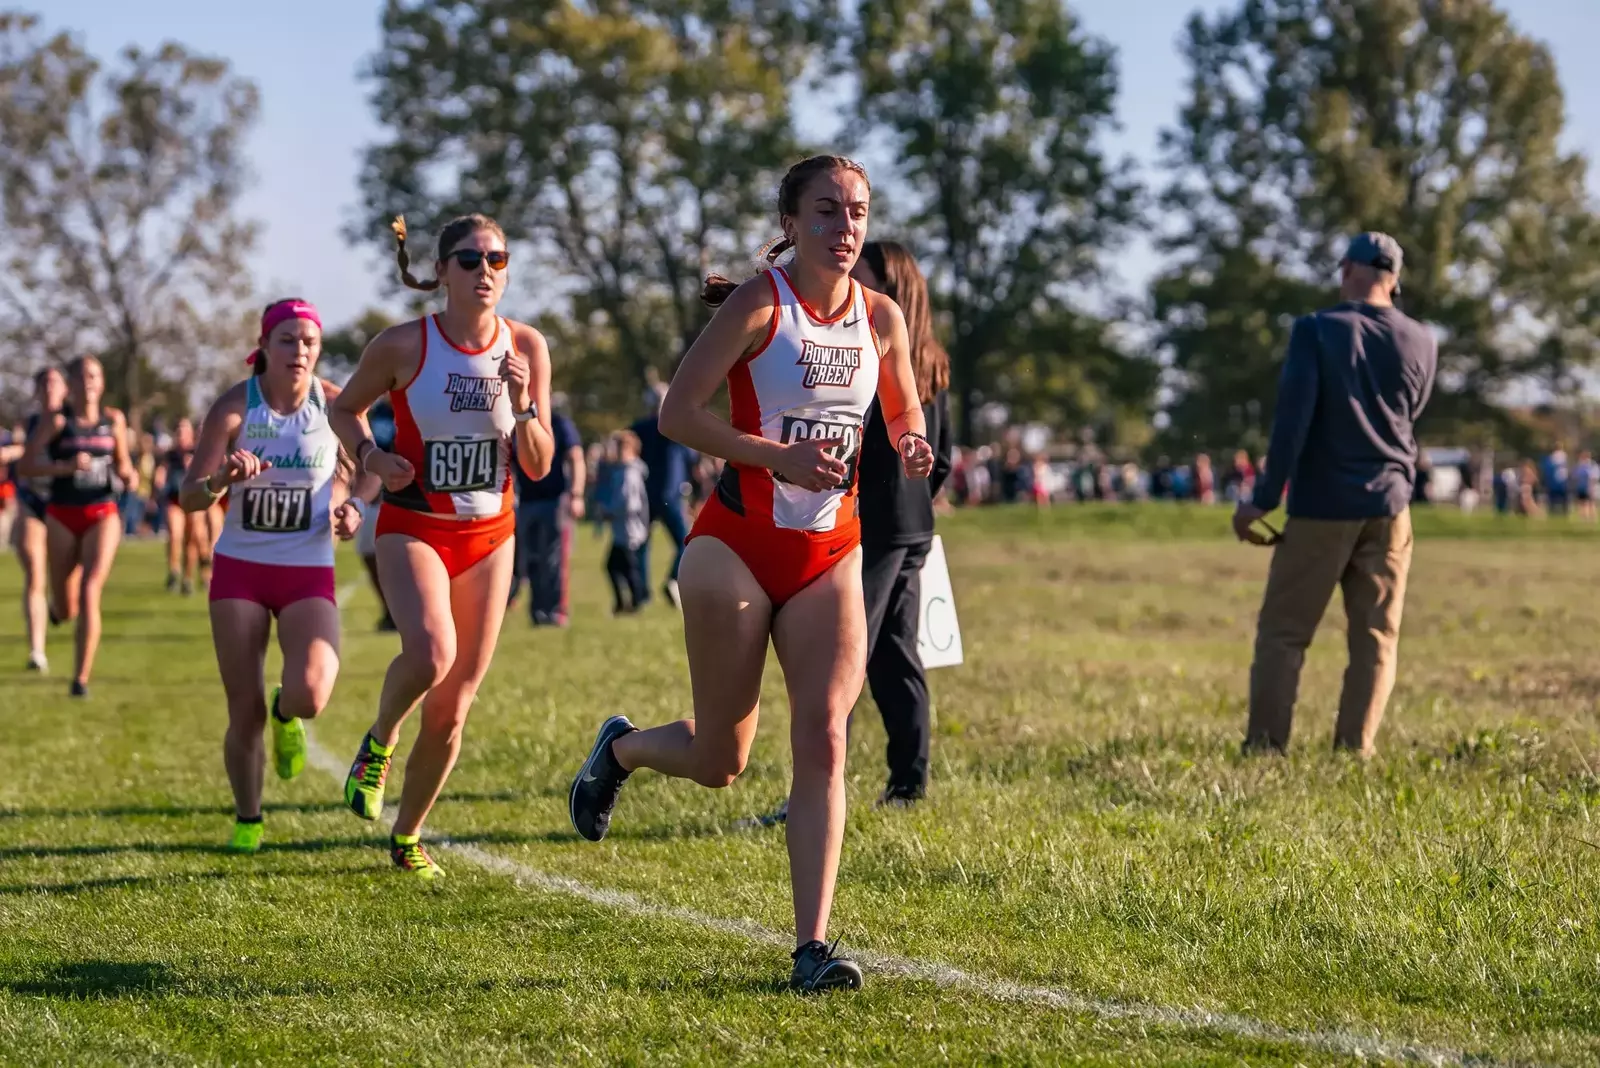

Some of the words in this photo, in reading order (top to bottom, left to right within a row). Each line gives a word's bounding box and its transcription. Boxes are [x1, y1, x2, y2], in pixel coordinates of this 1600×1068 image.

[799, 341, 860, 367] BOWLING
[448, 374, 501, 396] BOWLING
[804, 363, 854, 387] GREEN
[452, 392, 495, 411] GREEN
[430, 442, 492, 486] 6974
[247, 489, 306, 528] 7077
